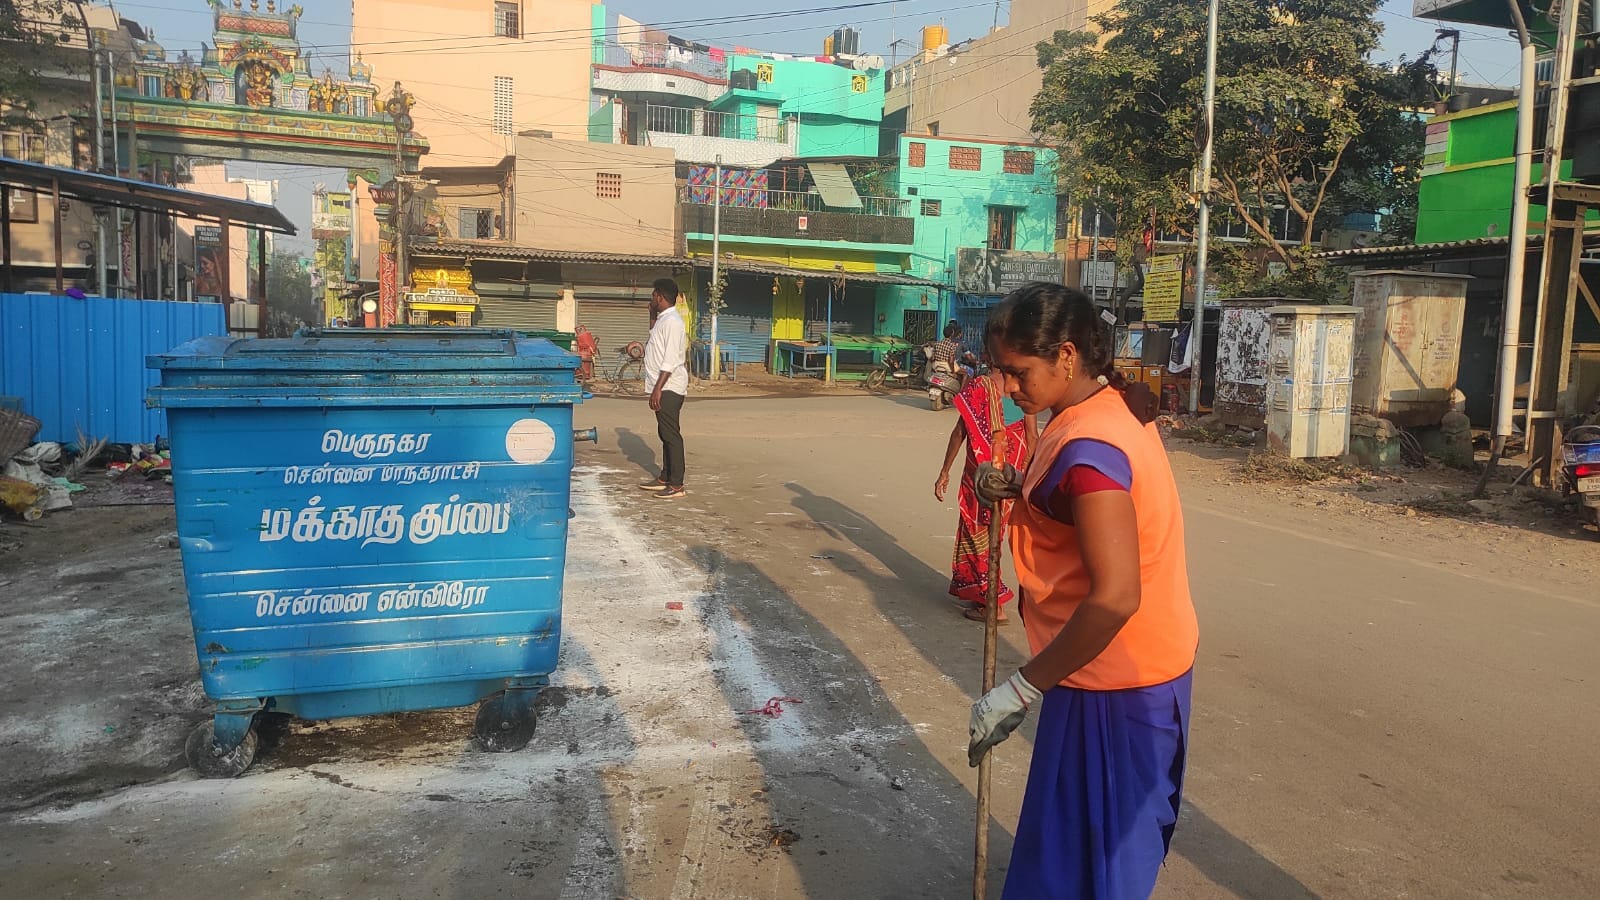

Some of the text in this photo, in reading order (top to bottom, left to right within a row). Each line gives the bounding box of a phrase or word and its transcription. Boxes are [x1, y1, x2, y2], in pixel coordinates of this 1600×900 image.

[1000, 261, 1023, 273] GANESH
[321, 429, 432, 460] பெருநகர
[284, 461, 481, 485] சென்னை மாநகராட்சி
[259, 494, 511, 549] மக்காத குப்பை
[256, 580, 490, 617] சென்னை என்விரோ
